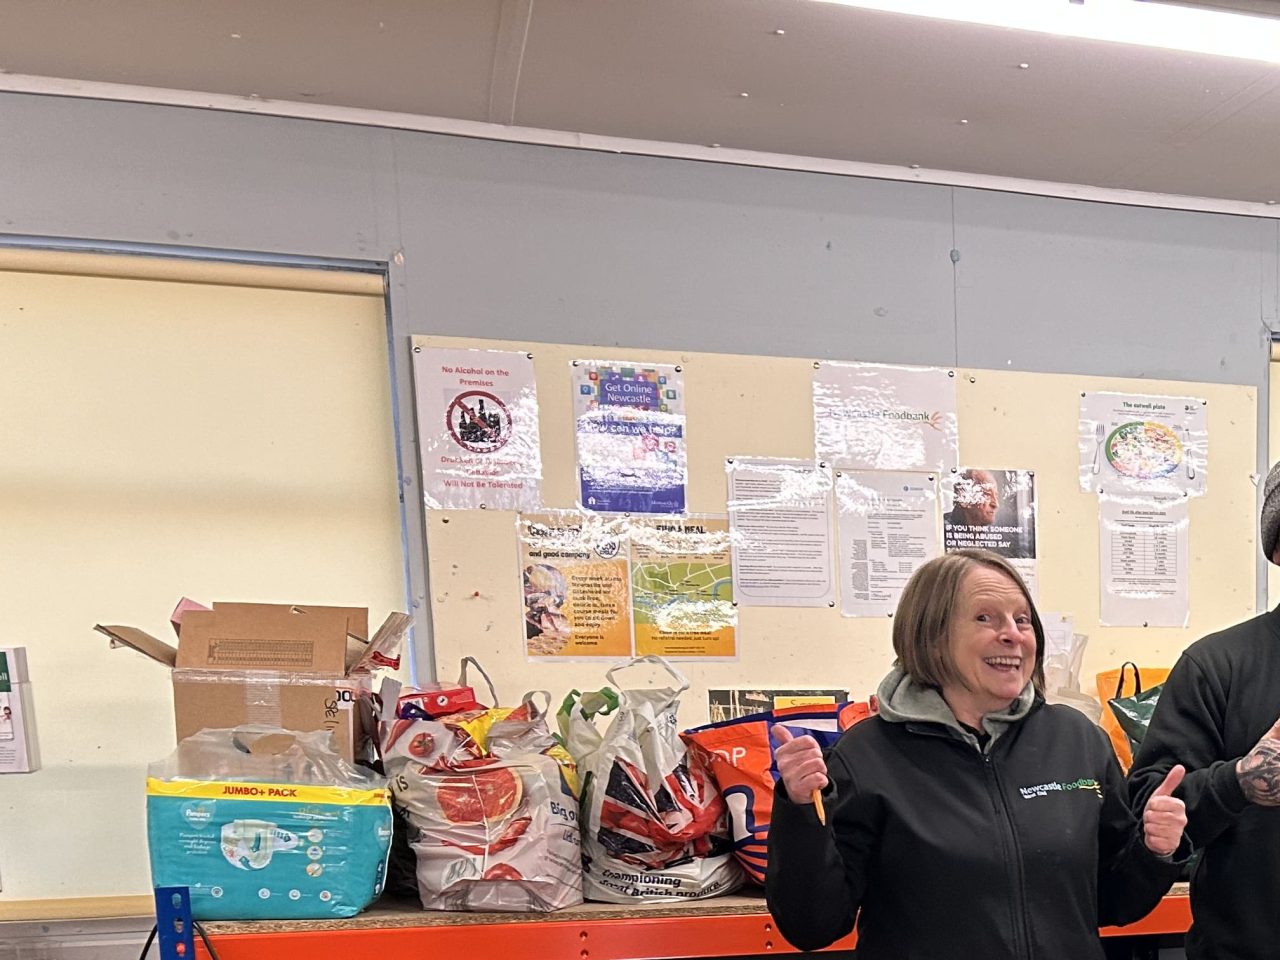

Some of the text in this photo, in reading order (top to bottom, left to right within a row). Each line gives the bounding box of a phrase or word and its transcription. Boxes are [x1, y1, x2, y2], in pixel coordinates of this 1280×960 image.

[455, 366, 483, 375] Alcohol
[485, 368, 495, 376] on
[497, 369, 509, 377] the
[459, 378, 494, 387] Premises
[605, 383, 653, 394] Get Online
[607, 393, 651, 403] Newcastle
[882, 409, 930, 421] Foodbank
[610, 425, 629, 433] can
[631, 426, 643, 434] we
[443, 480, 459, 488] Will
[461, 480, 474, 488] Not
[488, 481, 523, 489] Tolerated
[953, 524, 968, 532] YOU
[953, 532, 974, 540] BEING
[957, 540, 997, 548] NEGLECTED
[222, 786, 297, 798] JUMBO+ PACK
[1019, 781, 1063, 795] Newcastle
[185, 809, 211, 819] Pampers
